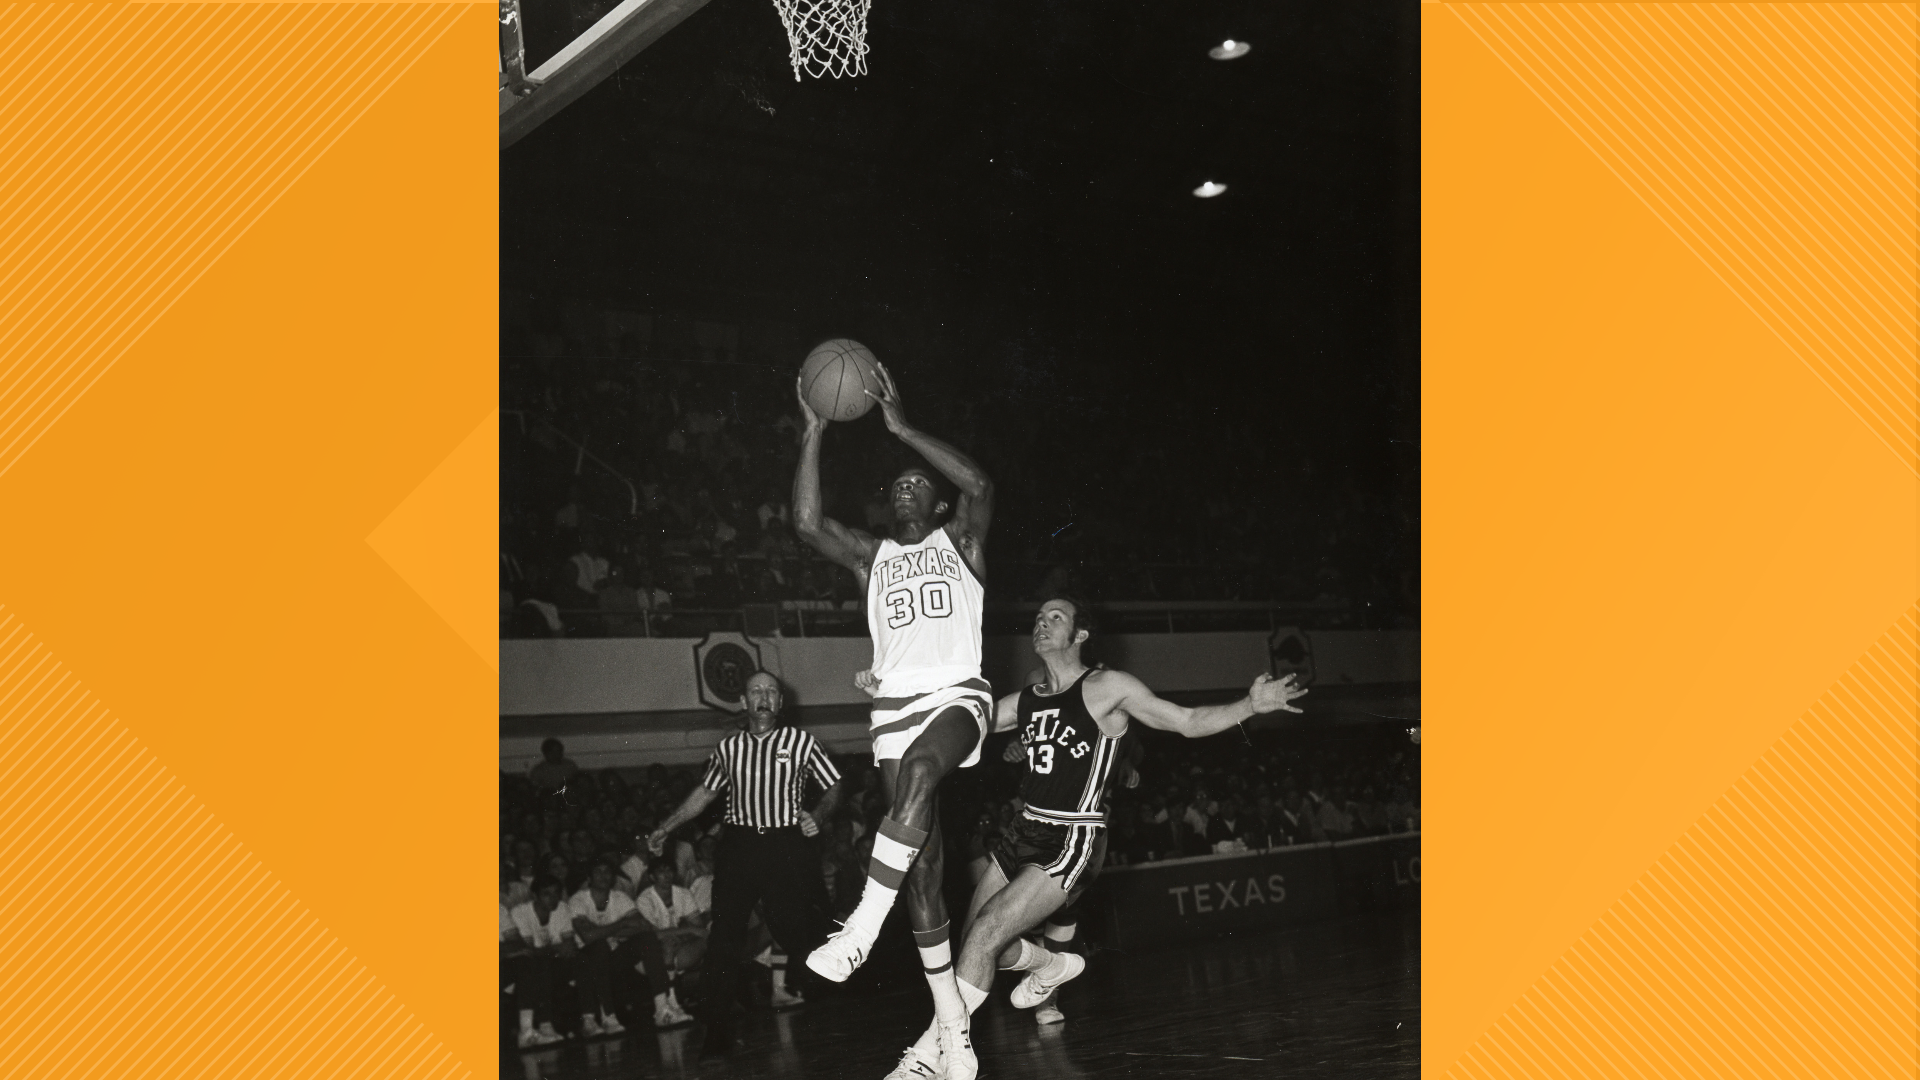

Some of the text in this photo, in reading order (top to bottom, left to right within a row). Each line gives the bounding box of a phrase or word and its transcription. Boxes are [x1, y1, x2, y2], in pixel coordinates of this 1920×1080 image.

[873, 546, 962, 596] TEXAS
[886, 580, 953, 630] 30
[1027, 744, 1054, 774] 13
[1168, 874, 1286, 916] TEXAS
